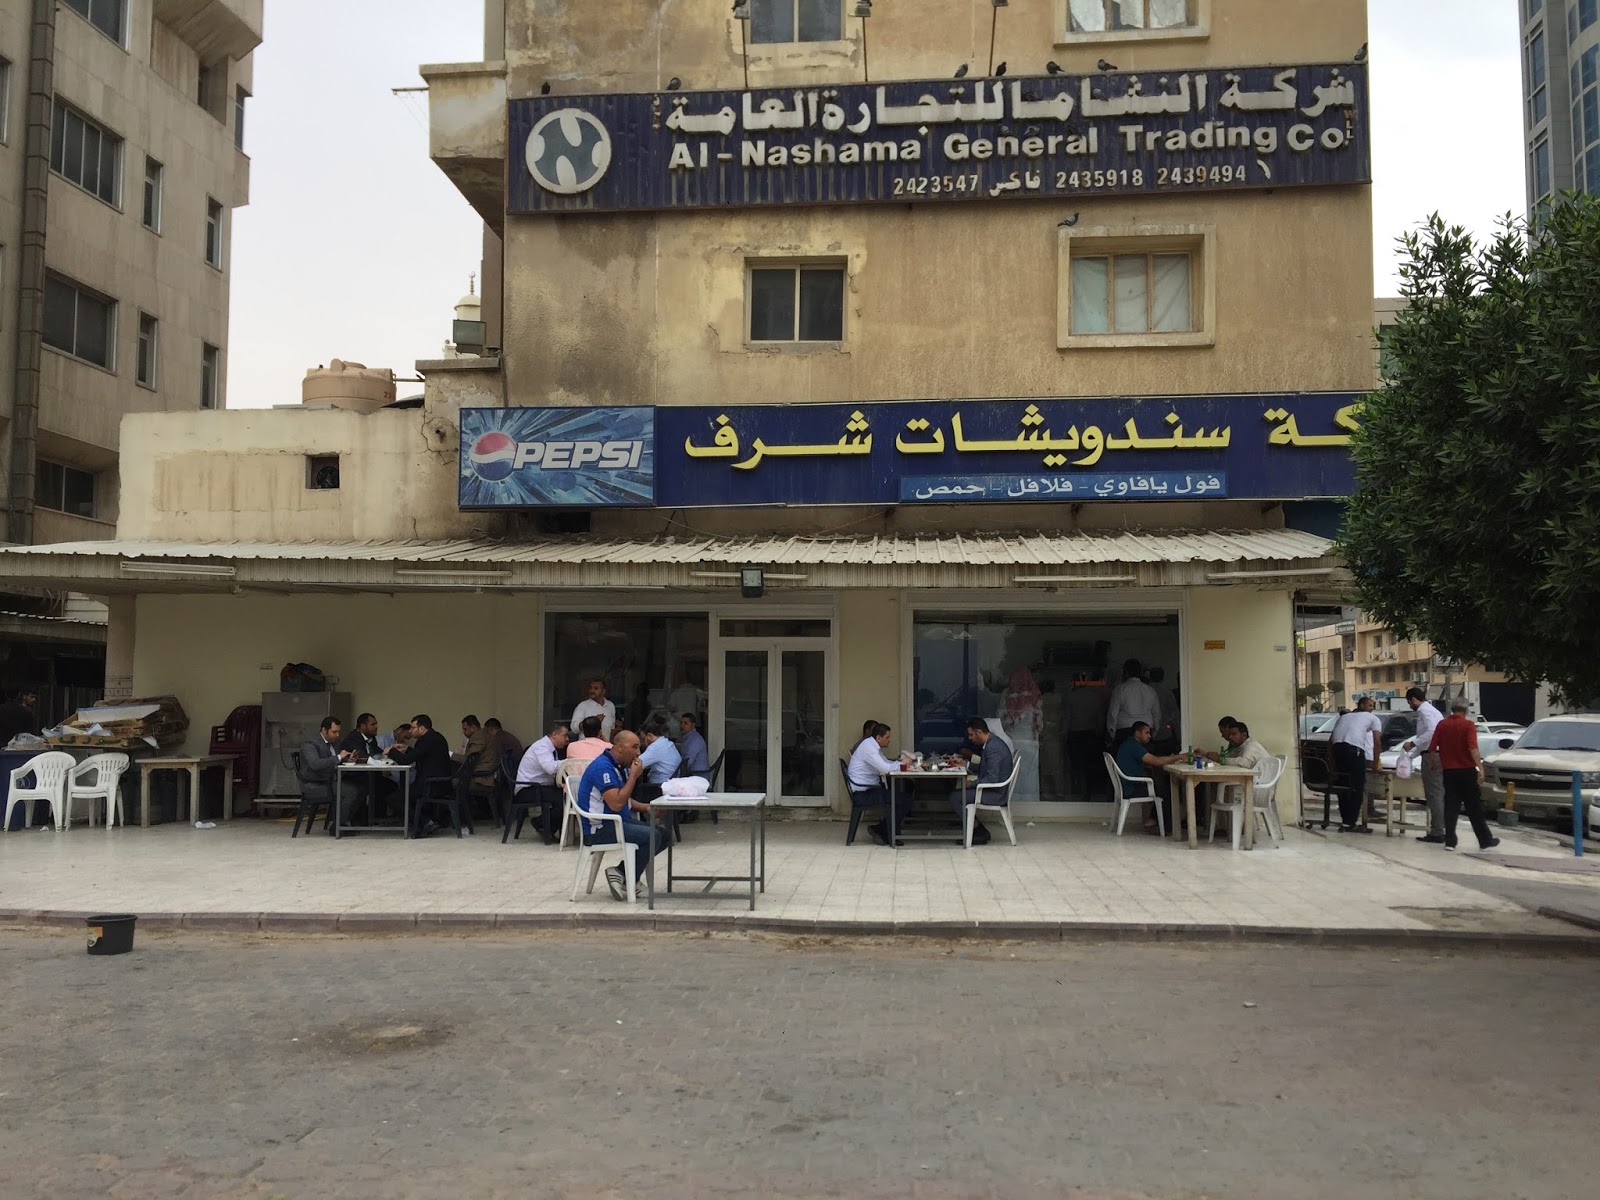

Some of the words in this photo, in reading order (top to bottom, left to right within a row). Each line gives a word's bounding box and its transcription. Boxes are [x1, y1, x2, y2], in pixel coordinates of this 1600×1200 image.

[821, 80, 1004, 136] للتجارة
[1219, 67, 1355, 117] شركة
[665, 90, 819, 135] العامة
[943, 126, 1099, 160] General
[1118, 120, 1278, 154] Trading
[893, 174, 979, 195] 2423547
[1056, 167, 1144, 189] 2435918
[1157, 164, 1247, 185] 2439494
[512, 440, 643, 470] PEPSI
[684, 409, 873, 471] شرف
[915, 484, 986, 499] حمص
[1007, 477, 1073, 497] فلافل
[1174, 475, 1221, 494] فول
